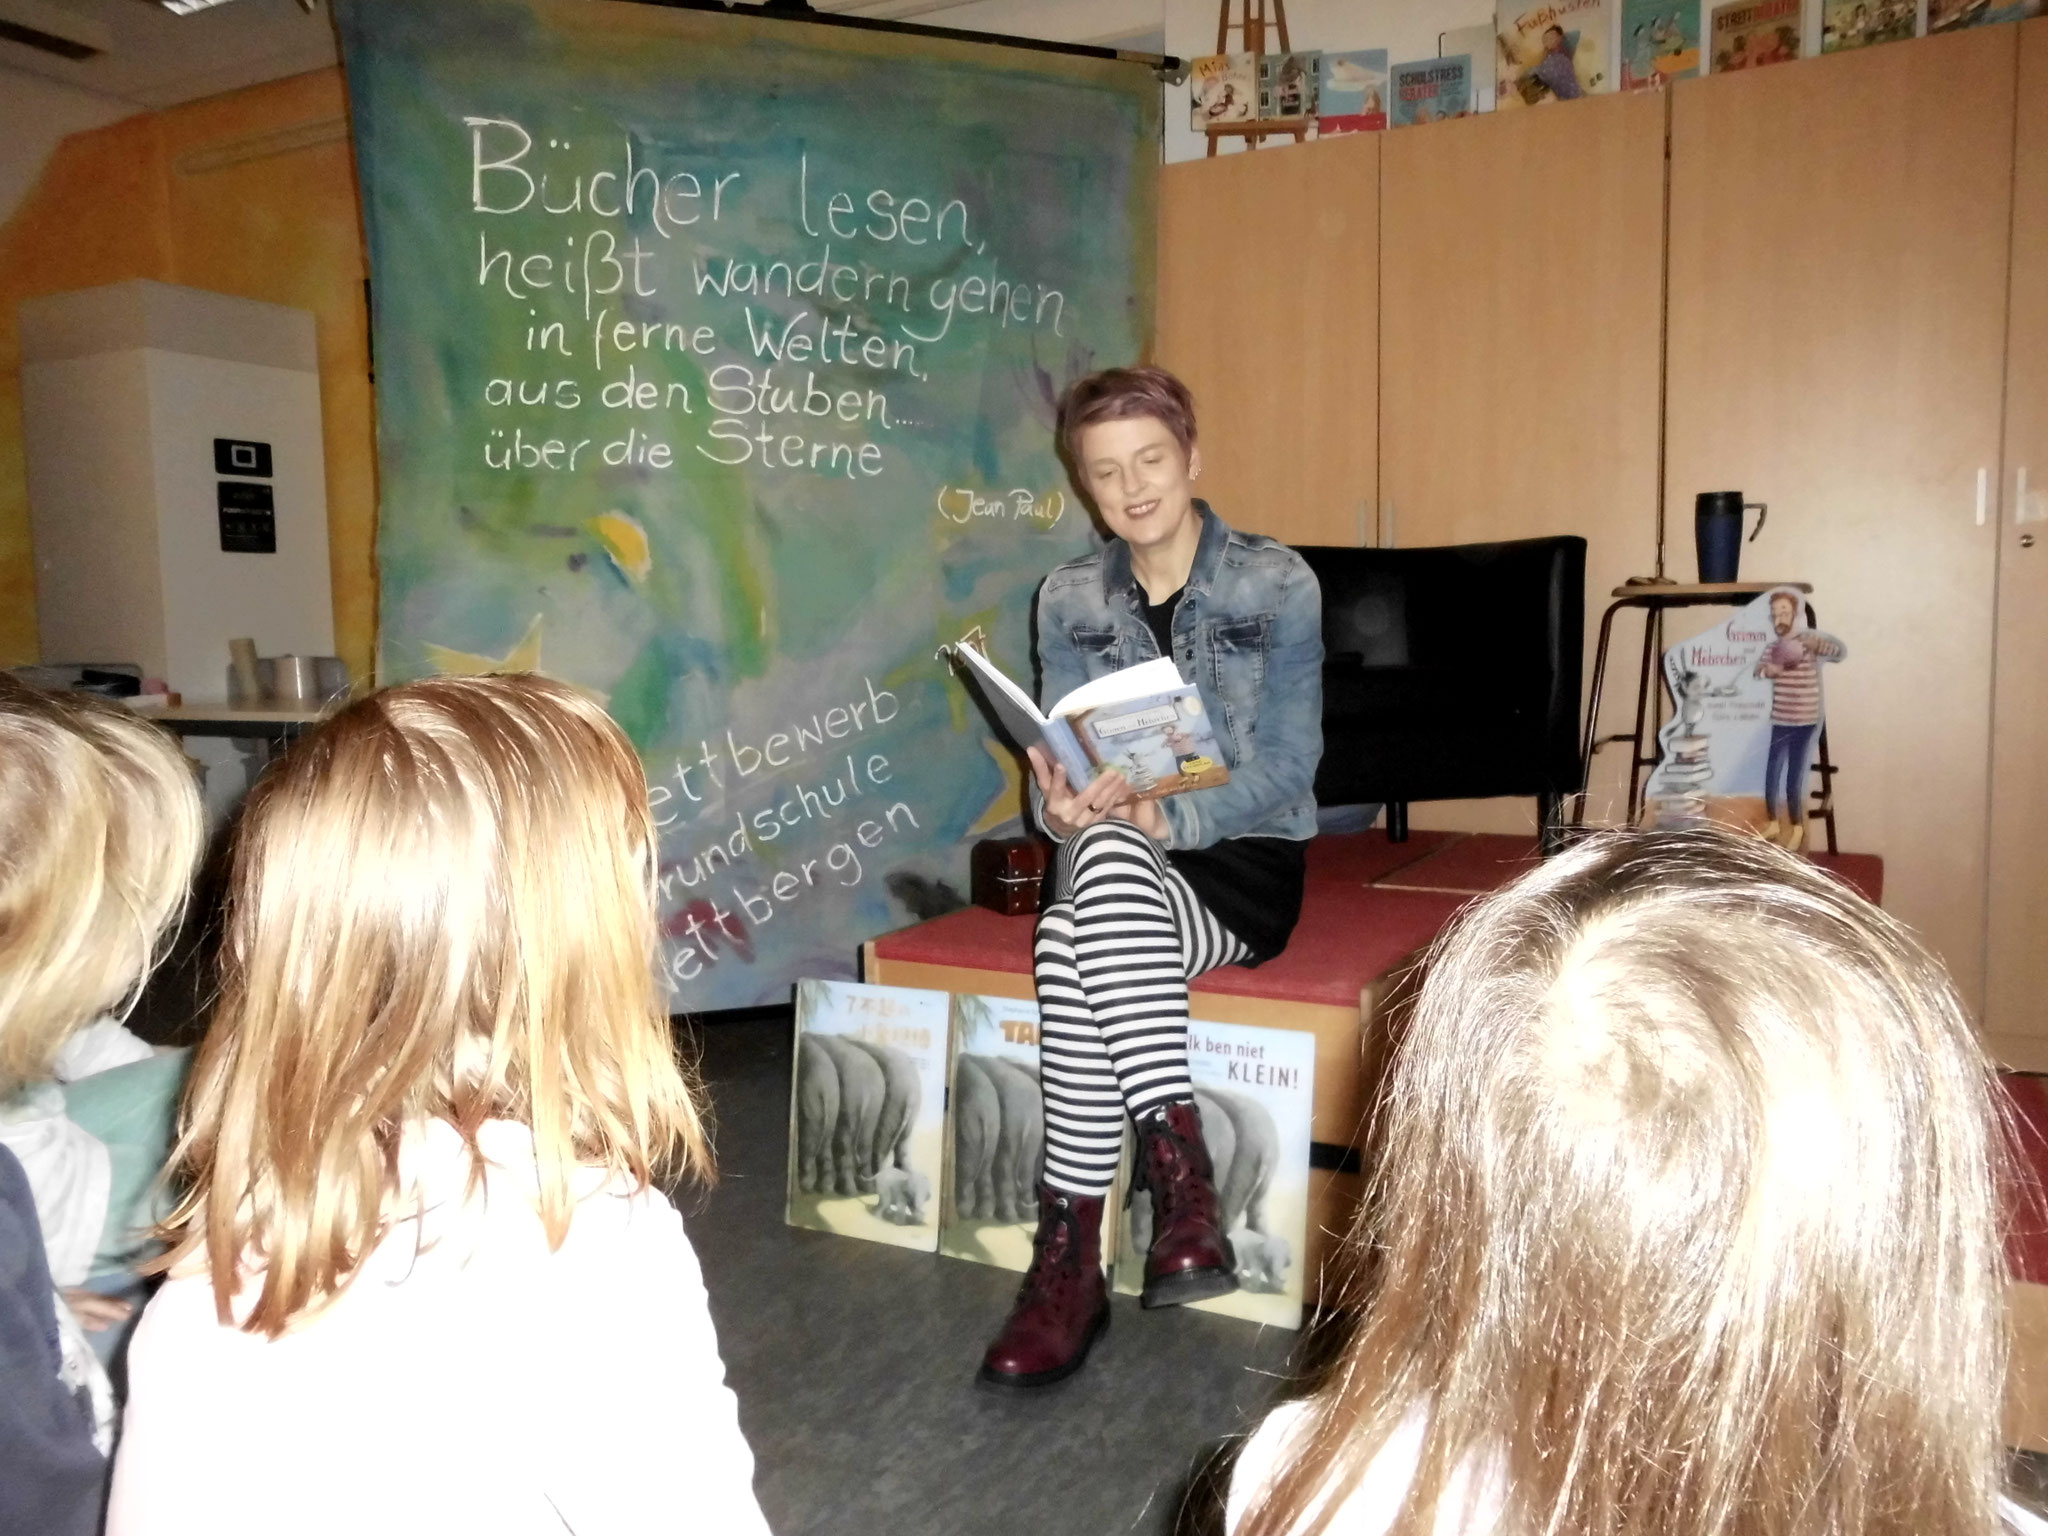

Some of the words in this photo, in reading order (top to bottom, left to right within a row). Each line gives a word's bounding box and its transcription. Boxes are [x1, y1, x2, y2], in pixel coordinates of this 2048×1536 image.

[463, 116, 740, 239] Bücher
[801, 150, 985, 255] lesen,
[479, 230, 657, 321] heißt
[693, 244, 910, 312] wandern
[901, 258, 1064, 342] gehen
[527, 308, 573, 357] in
[592, 308, 716, 370] ferne
[485, 378, 581, 410] aus
[601, 364, 693, 413] den
[484, 429, 591, 472] über
[602, 428, 673, 469] die
[697, 419, 883, 480] Sterne
[937, 485, 1006, 524] (Jean
[1007, 488, 1065, 530] Paul)
[648, 676, 900, 827] ettbewerb
[659, 754, 893, 901] rundschule
[1206, 1036, 1232, 1055] ben
[1236, 1041, 1265, 1059] niet
[1227, 1060, 1298, 1089] KLEIN!
